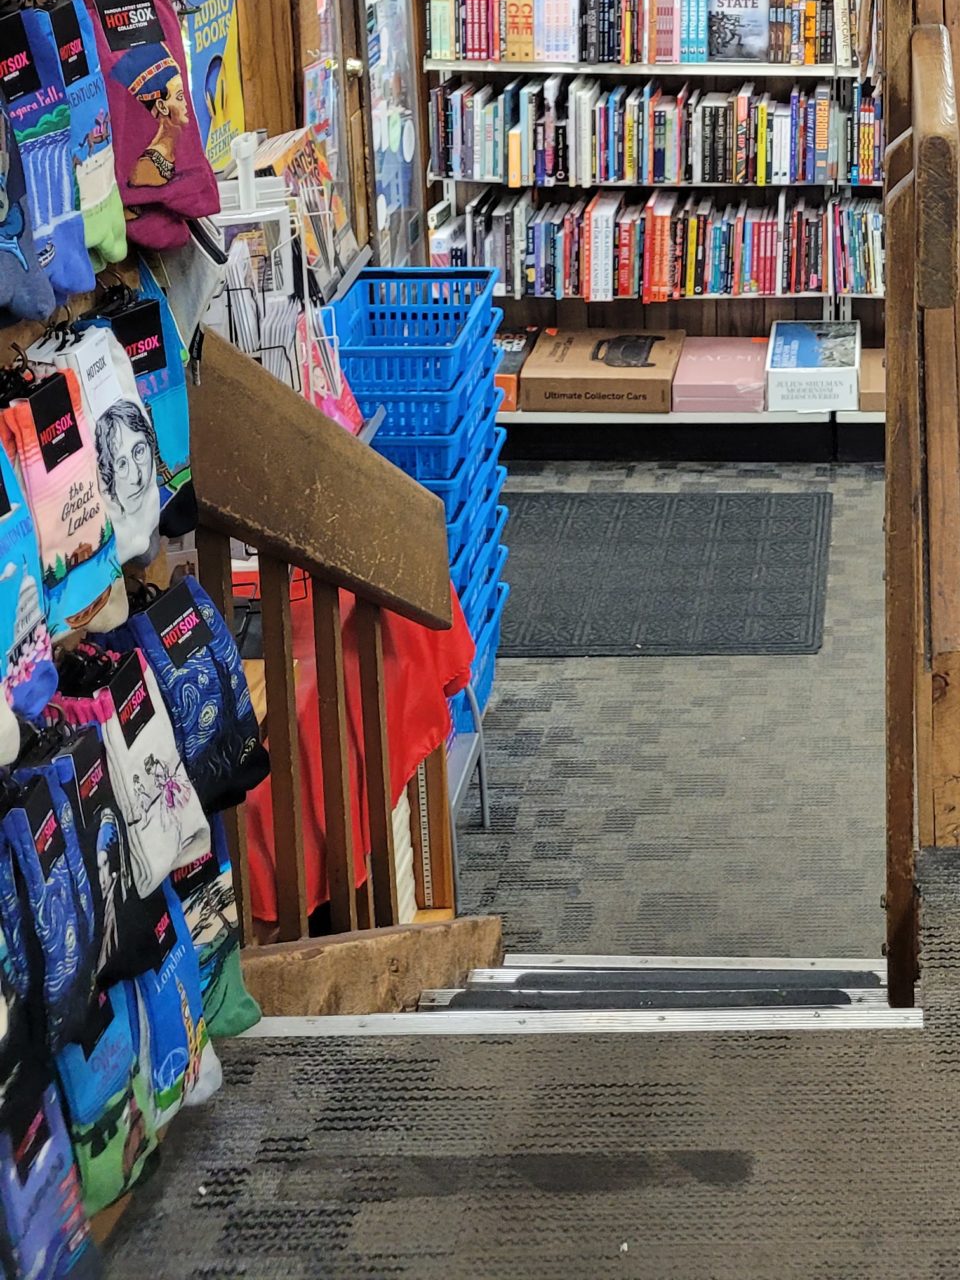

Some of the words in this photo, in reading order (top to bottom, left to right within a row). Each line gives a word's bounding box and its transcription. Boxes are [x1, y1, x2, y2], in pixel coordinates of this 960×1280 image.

[106, 8, 156, 29] HOTSOX
[118, 22, 148, 32] COLLECTION
[508, 3, 520, 36] CHE
[521, 3, 533, 36] CHE
[841, 8, 849, 27] NICK
[195, 13, 232, 54] BOOKS
[841, 28, 849, 49] CAVE
[60, 37, 83, 61] HOTSOX
[10, 103, 38, 121] agara
[208, 128, 240, 158] ISTENING
[211, 122, 231, 143] START
[621, 224, 630, 244] BLACK
[621, 247, 630, 264] HOLE
[86, 356, 107, 382] HOTSOX
[544, 391, 582, 401] Ultimate
[584, 391, 623, 402] Collector
[626, 392, 647, 401] Cars
[805, 381, 844, 389] SHULMAN
[41, 412, 75, 447] HOTSOX
[62, 481, 95, 522] Great
[69, 481, 84, 501] the
[68, 502, 101, 537] Lakes
[162, 611, 200, 648] HOTSOX
[120, 685, 147, 725] HOTSOX
[154, 945, 186, 993] London
